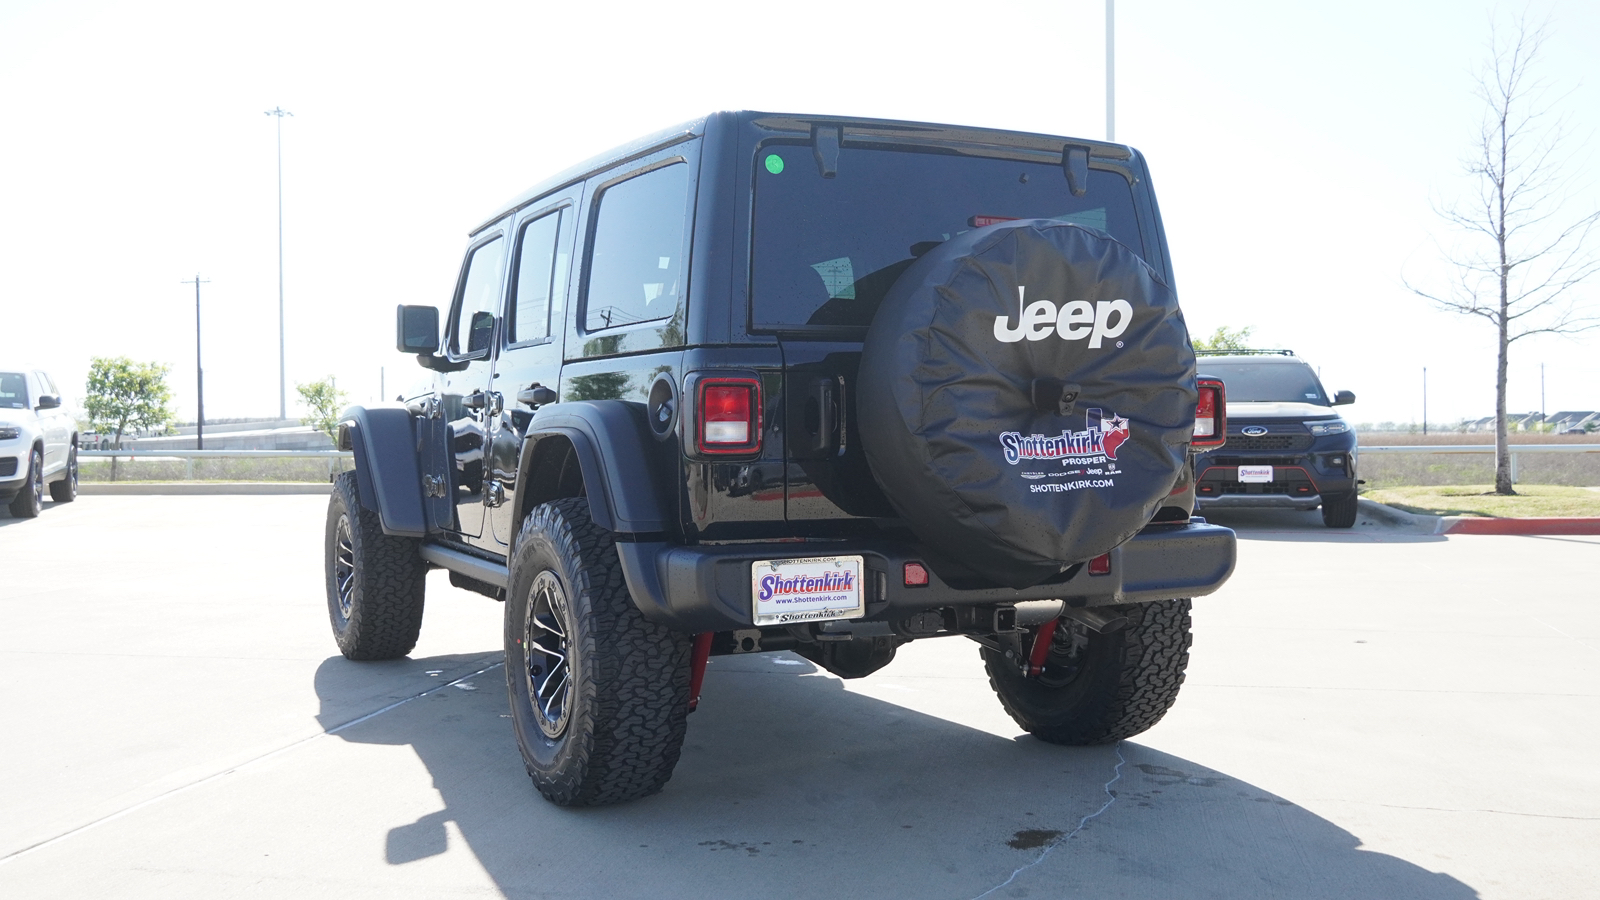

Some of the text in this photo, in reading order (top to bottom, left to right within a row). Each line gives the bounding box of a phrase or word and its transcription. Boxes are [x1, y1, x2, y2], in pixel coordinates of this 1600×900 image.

[993, 286, 1134, 349] Jeep
[999, 426, 1105, 465] Shottenkirk
[1062, 456, 1106, 466] PROSPER
[1048, 469, 1081, 477] DODGE
[1086, 467, 1103, 476] Jeep
[1030, 479, 1114, 492] SHOTTENKIRK.COM
[758, 570, 856, 602] Shottenkirk
[775, 595, 847, 604] www.Shottenkirk.com
[780, 610, 836, 621] Shottenkirk
